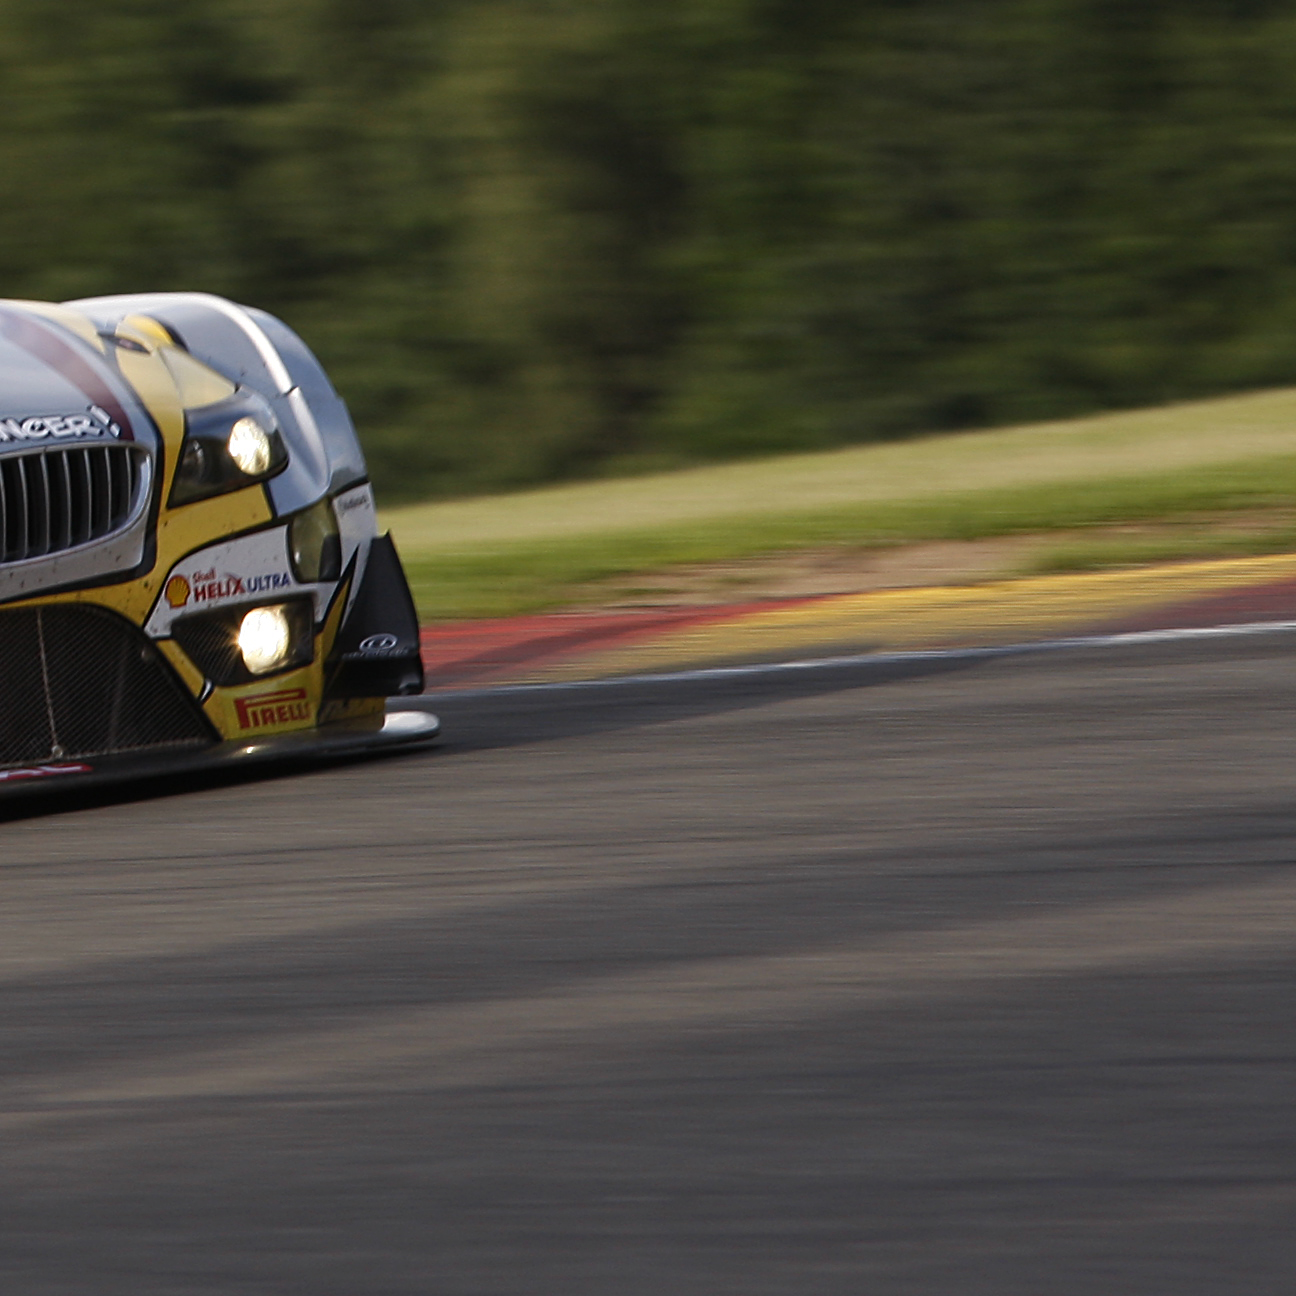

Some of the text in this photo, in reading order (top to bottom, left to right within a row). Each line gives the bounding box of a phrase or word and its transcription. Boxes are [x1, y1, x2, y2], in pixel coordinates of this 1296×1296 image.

[193, 571, 291, 603] HELIX ULTRA
[234, 687, 313, 731] PIRELLI
